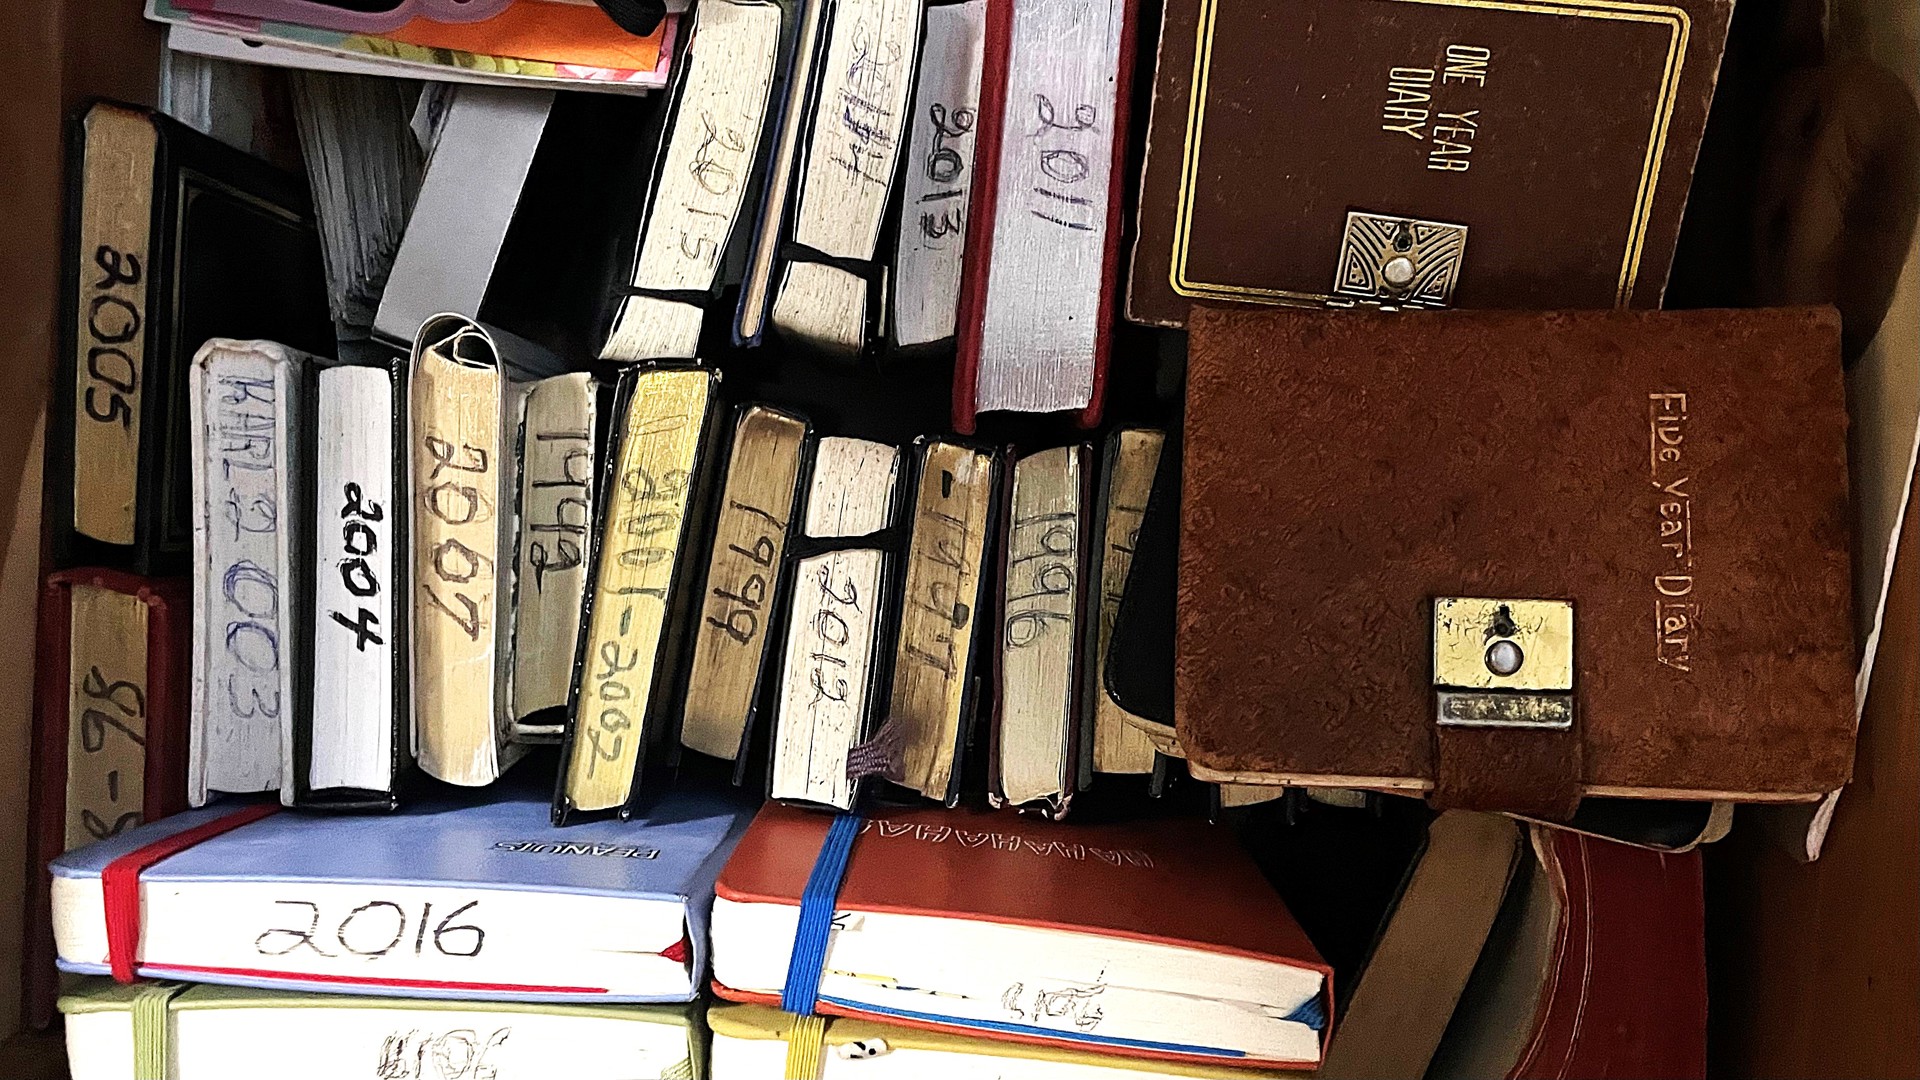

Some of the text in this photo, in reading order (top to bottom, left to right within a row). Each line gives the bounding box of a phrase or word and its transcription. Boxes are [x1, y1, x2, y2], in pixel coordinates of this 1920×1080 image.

[1028, 94, 1098, 231] 2011
[1382, 67, 1436, 140] DIARY
[1427, 44, 1491, 172] ONE YEAR
[681, 110, 745, 268] 2015
[917, 103, 974, 250] 2013
[86, 245, 142, 429] 2005
[218, 375, 276, 480] KARL
[328, 482, 385, 652] 2004
[424, 435, 494, 643] 2007
[706, 500, 789, 647] 1999
[1007, 512, 1077, 649] 1996
[1650, 393, 1696, 673] Five Year Diary
[807, 564, 863, 708] 2012
[490, 840, 661, 861] PEANUTS
[255, 900, 485, 960] 2016
